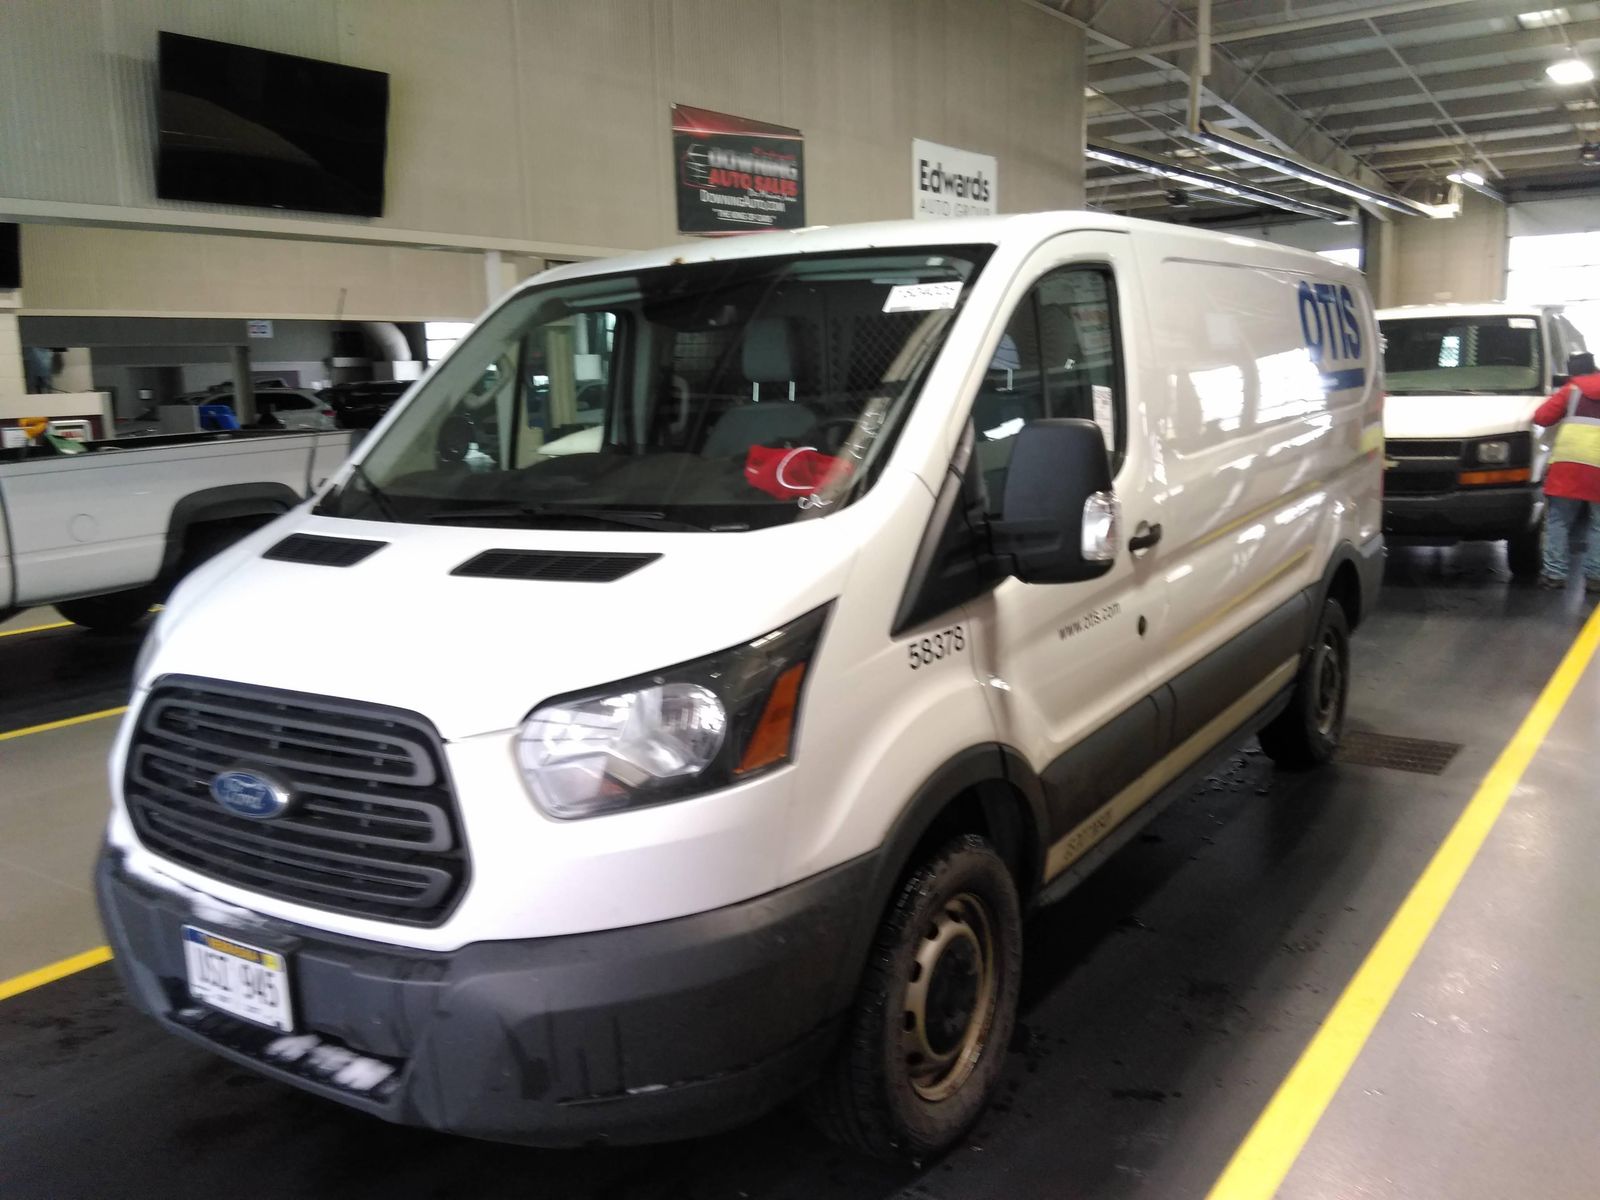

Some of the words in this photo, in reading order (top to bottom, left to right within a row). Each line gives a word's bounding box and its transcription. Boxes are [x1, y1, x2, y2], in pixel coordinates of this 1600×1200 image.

[708, 167, 753, 190] AUTO
[753, 174, 799, 197] SALES
[920, 159, 990, 202] Edwards
[920, 198, 951, 216] AUTO
[1297, 280, 1362, 361] OTIS
[909, 626, 965, 671] 58378
